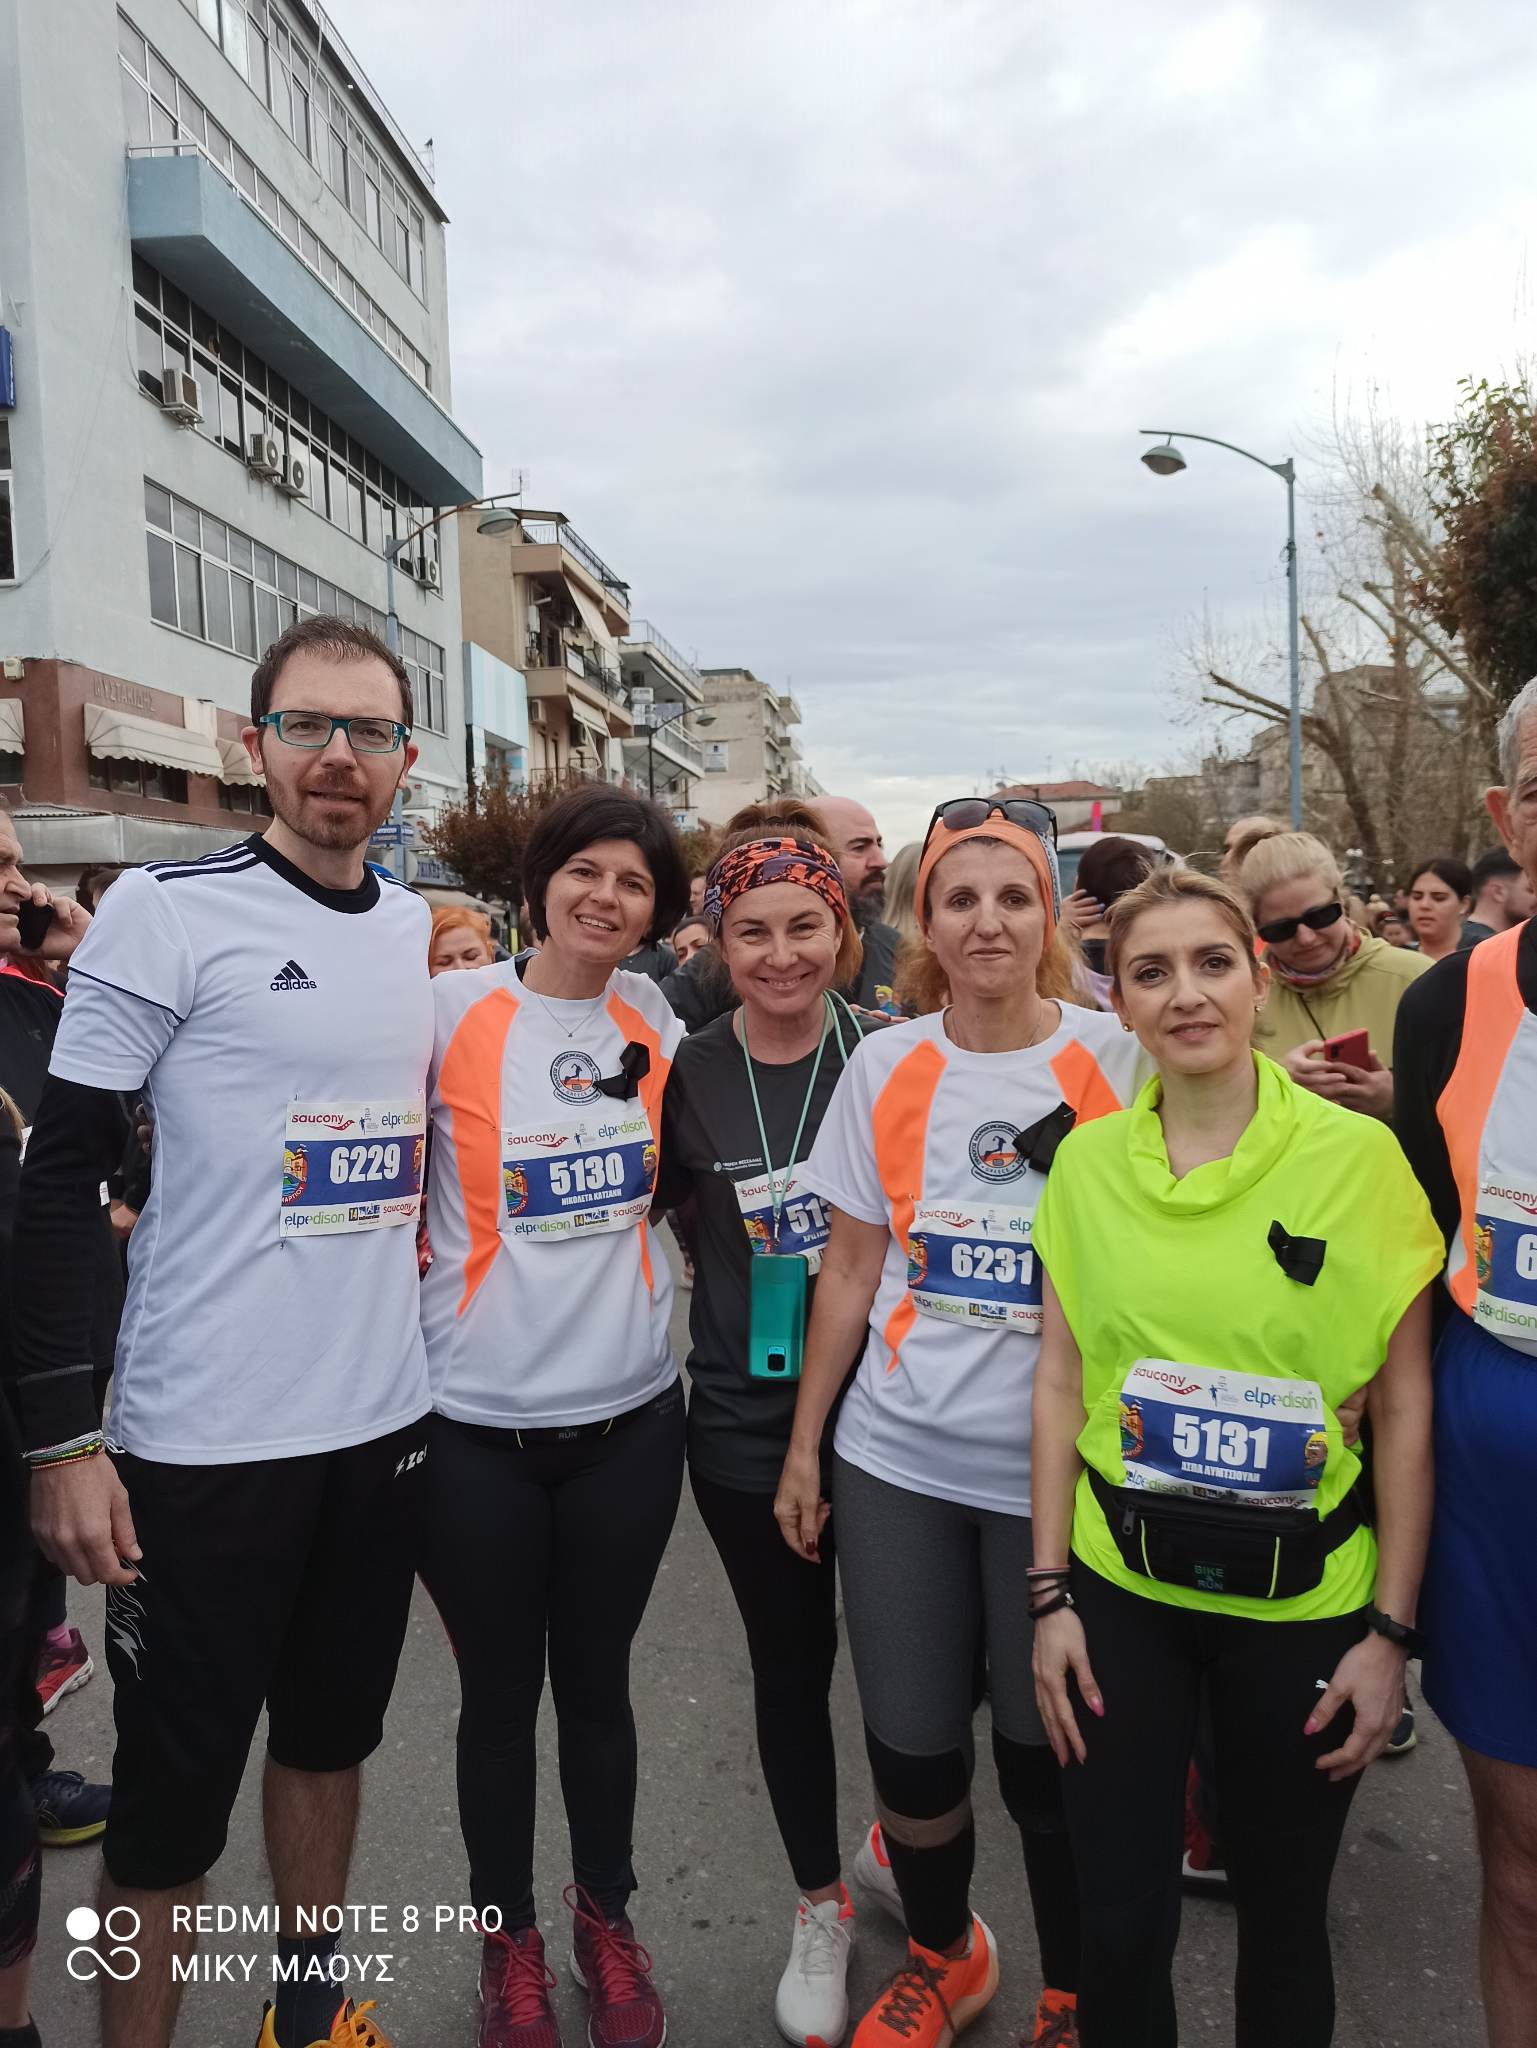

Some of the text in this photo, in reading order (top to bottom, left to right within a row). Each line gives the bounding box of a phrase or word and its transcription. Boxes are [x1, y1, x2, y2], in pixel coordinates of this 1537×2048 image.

[270, 978, 317, 991] adidas
[291, 1113, 344, 1125] saucony
[598, 1119, 647, 1139] elpedison
[507, 1133, 556, 1145] saucony
[329, 1143, 401, 1185] 6229
[550, 1152, 625, 1196] 5130
[613, 1202, 644, 1217] saucony
[284, 1210, 345, 1228] elpedison
[514, 1219, 571, 1235] elpedison
[951, 1243, 1033, 1286] 6231
[1133, 1366, 1187, 1386] saucony
[1244, 1386, 1318, 1409] elpedison
[1172, 1412, 1270, 1470] 5131
[1194, 1565, 1224, 1578] BIKE
[1197, 1579, 1224, 1591] RUN
